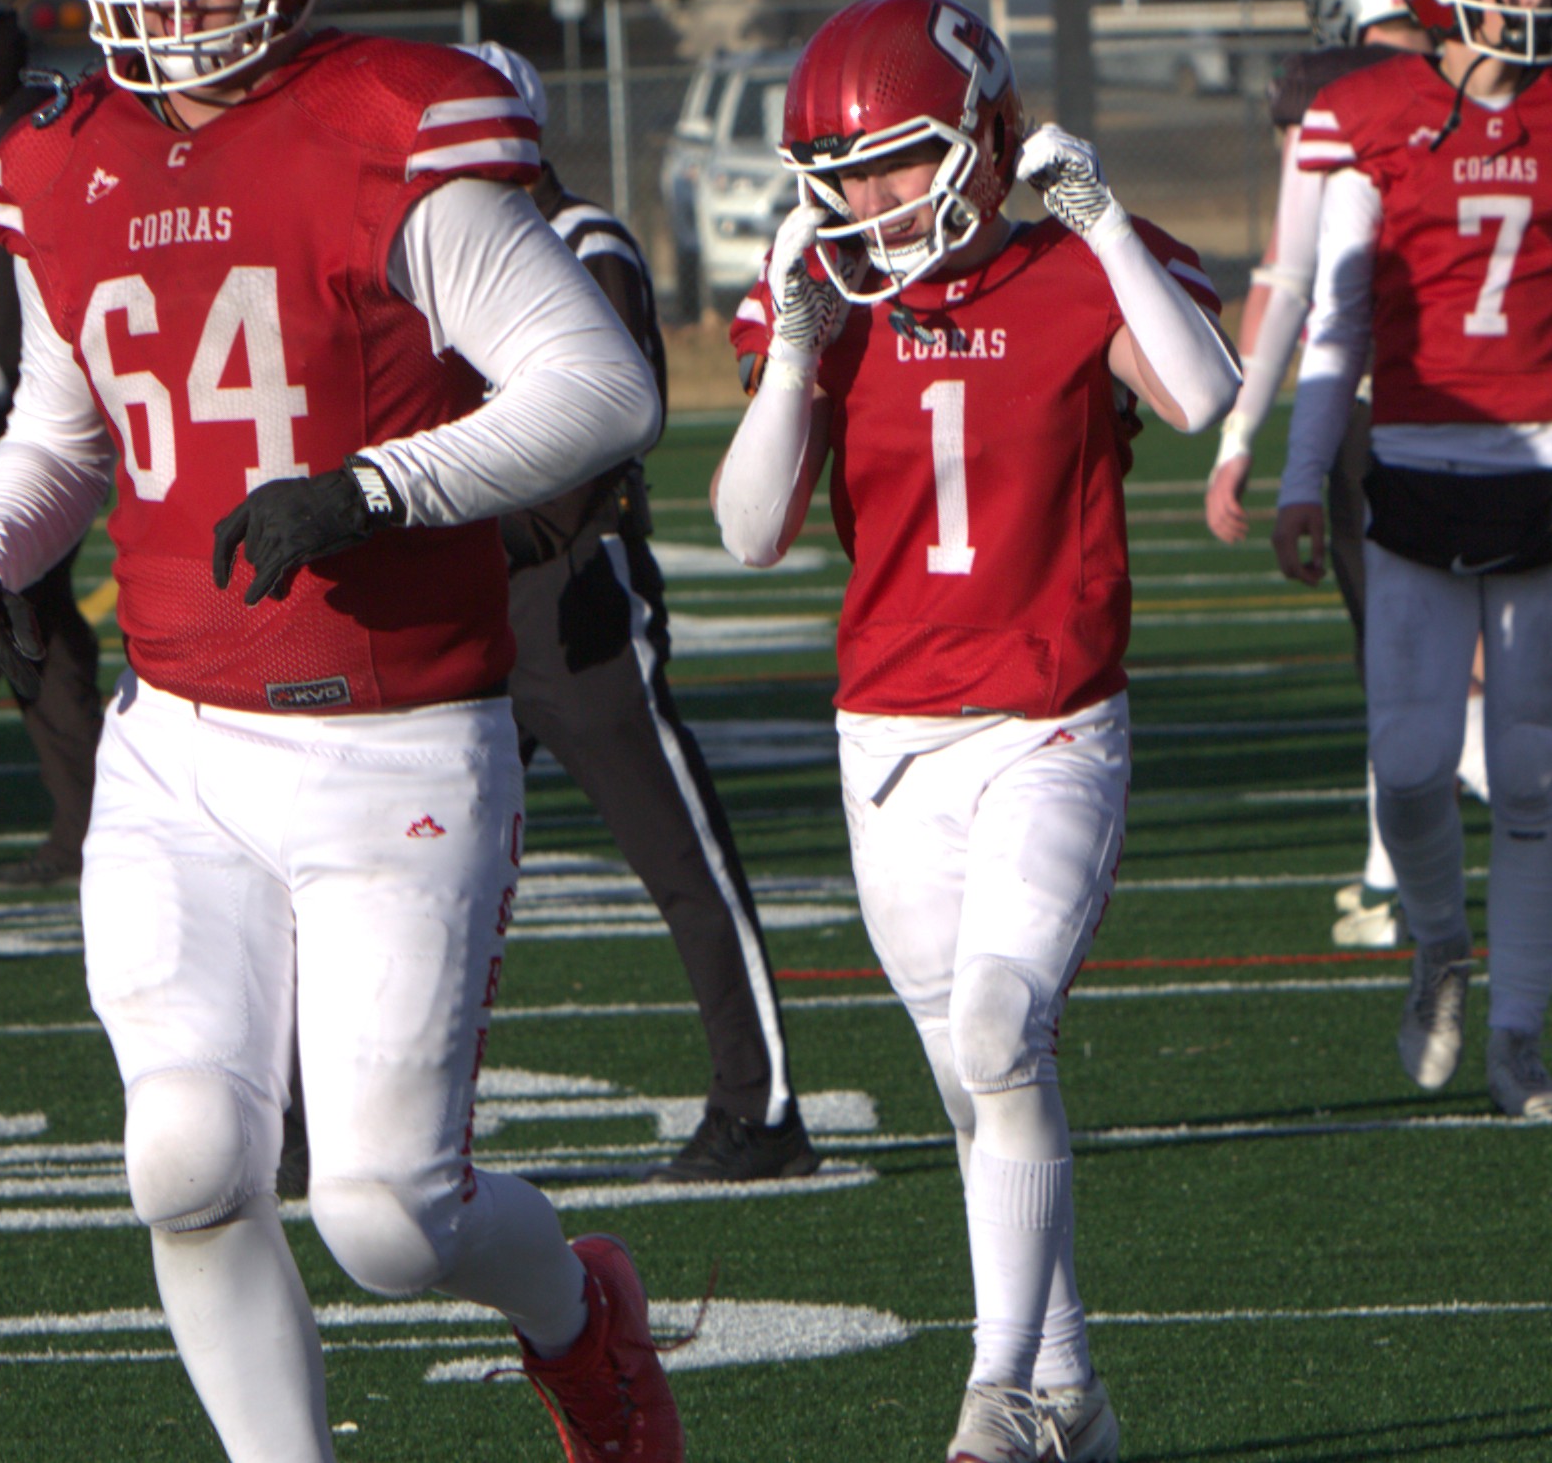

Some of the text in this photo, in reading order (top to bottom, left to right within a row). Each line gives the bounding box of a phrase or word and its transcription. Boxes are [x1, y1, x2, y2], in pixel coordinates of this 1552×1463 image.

[166, 141, 192, 168] C
[1453, 156, 1537, 184] COBRAS
[128, 206, 232, 251] COBRAS
[1458, 194, 1532, 335] 7
[81, 266, 309, 502] 64
[352, 466, 393, 513] NIKE
[920, 380, 976, 575] 1
